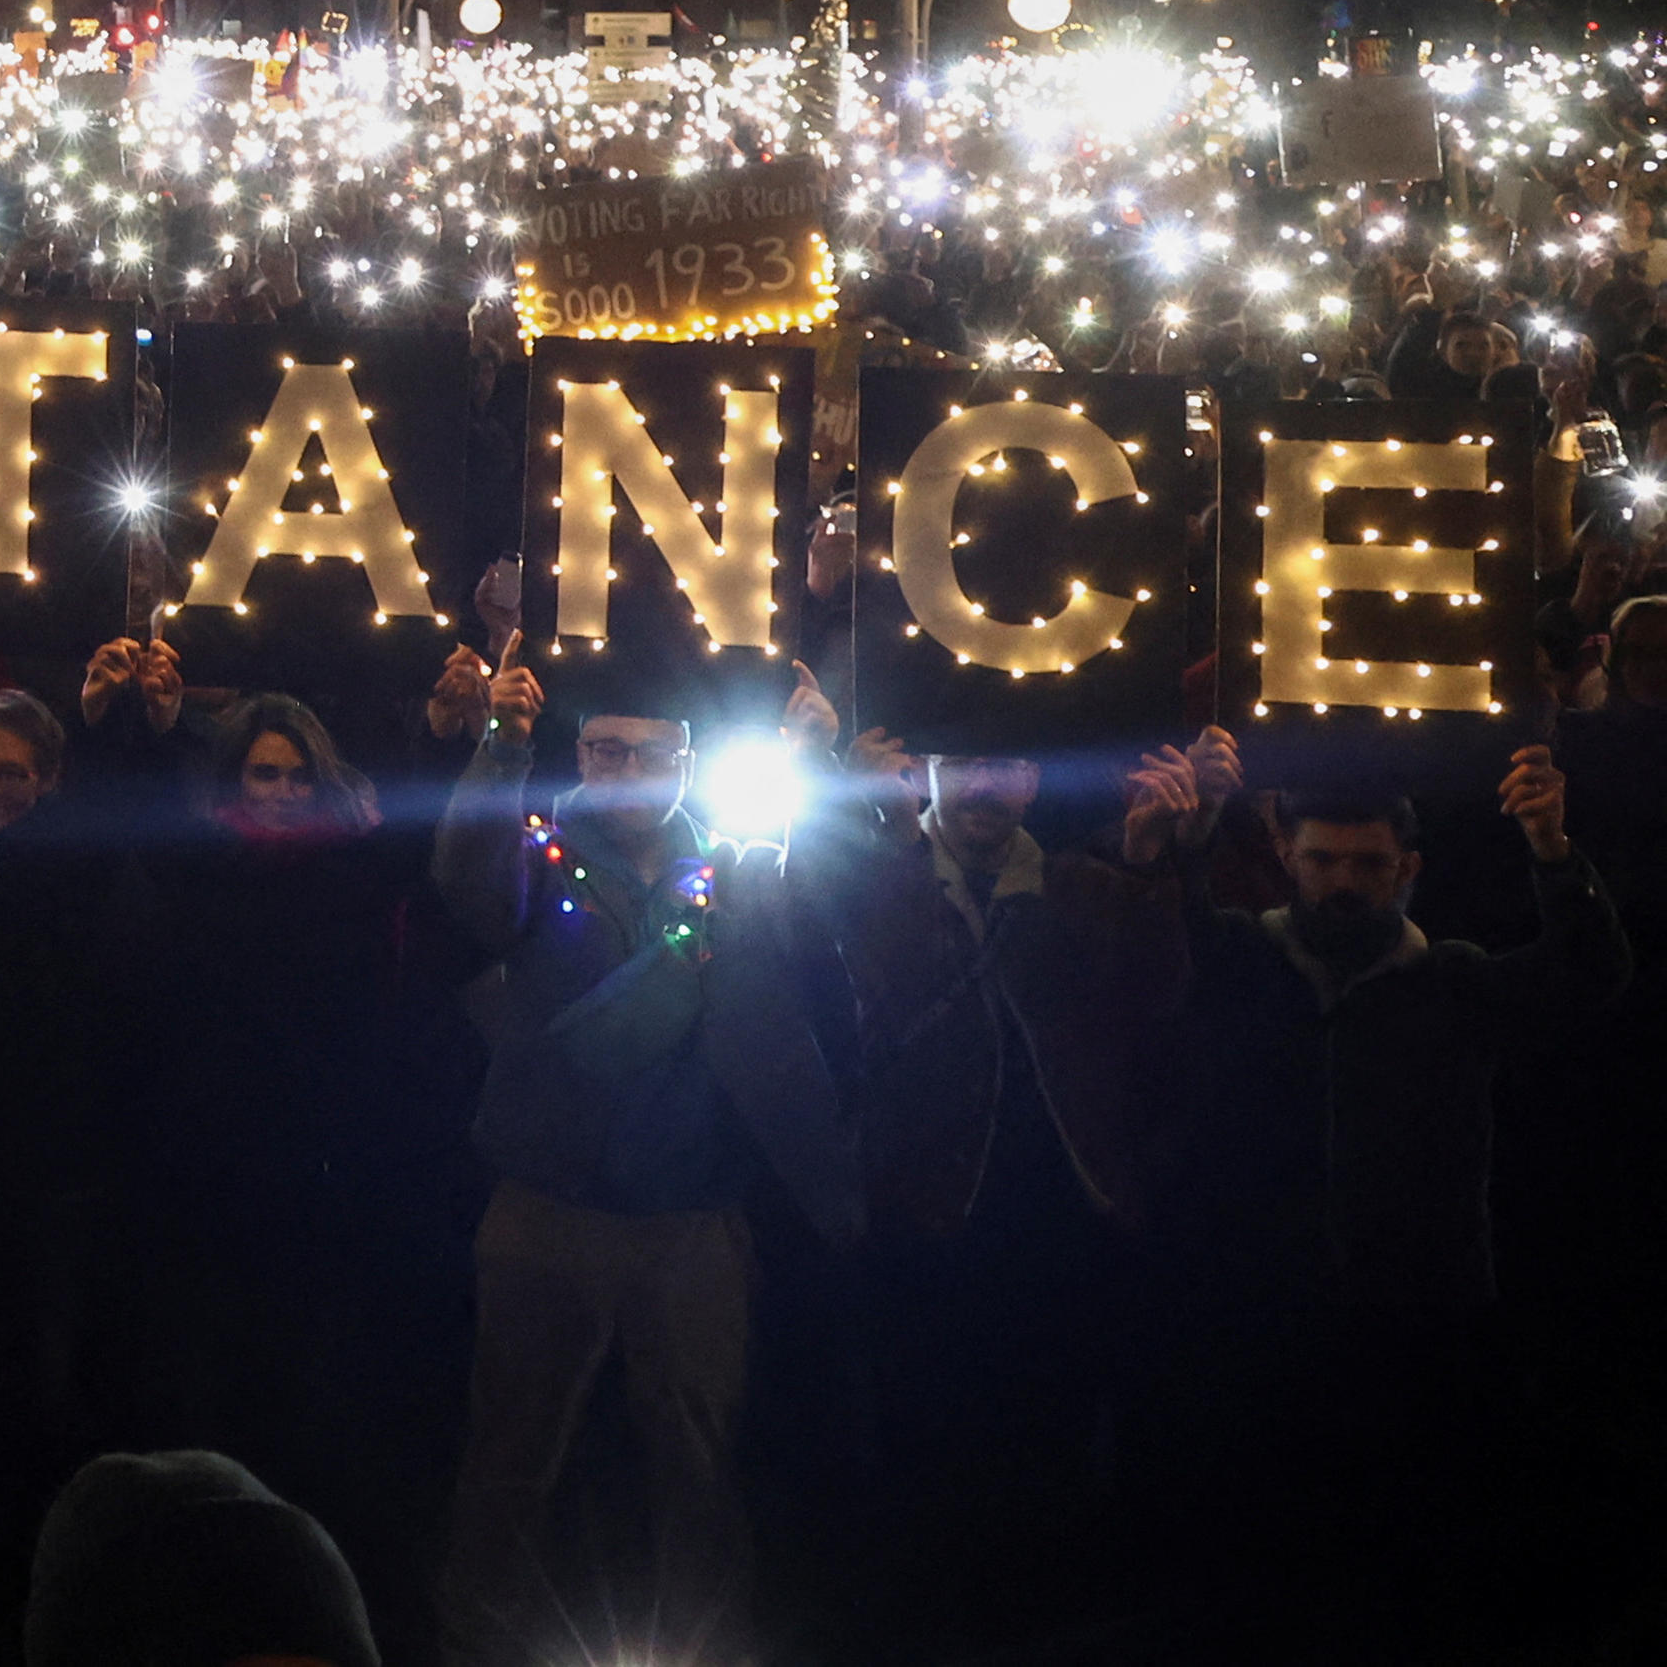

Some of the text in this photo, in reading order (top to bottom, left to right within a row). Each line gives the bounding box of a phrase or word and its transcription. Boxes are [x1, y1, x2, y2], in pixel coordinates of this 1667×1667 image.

[524, 183, 822, 245] VOTING FAR RIGHT
[562, 251, 592, 279] IS
[645, 235, 797, 310] 1933
